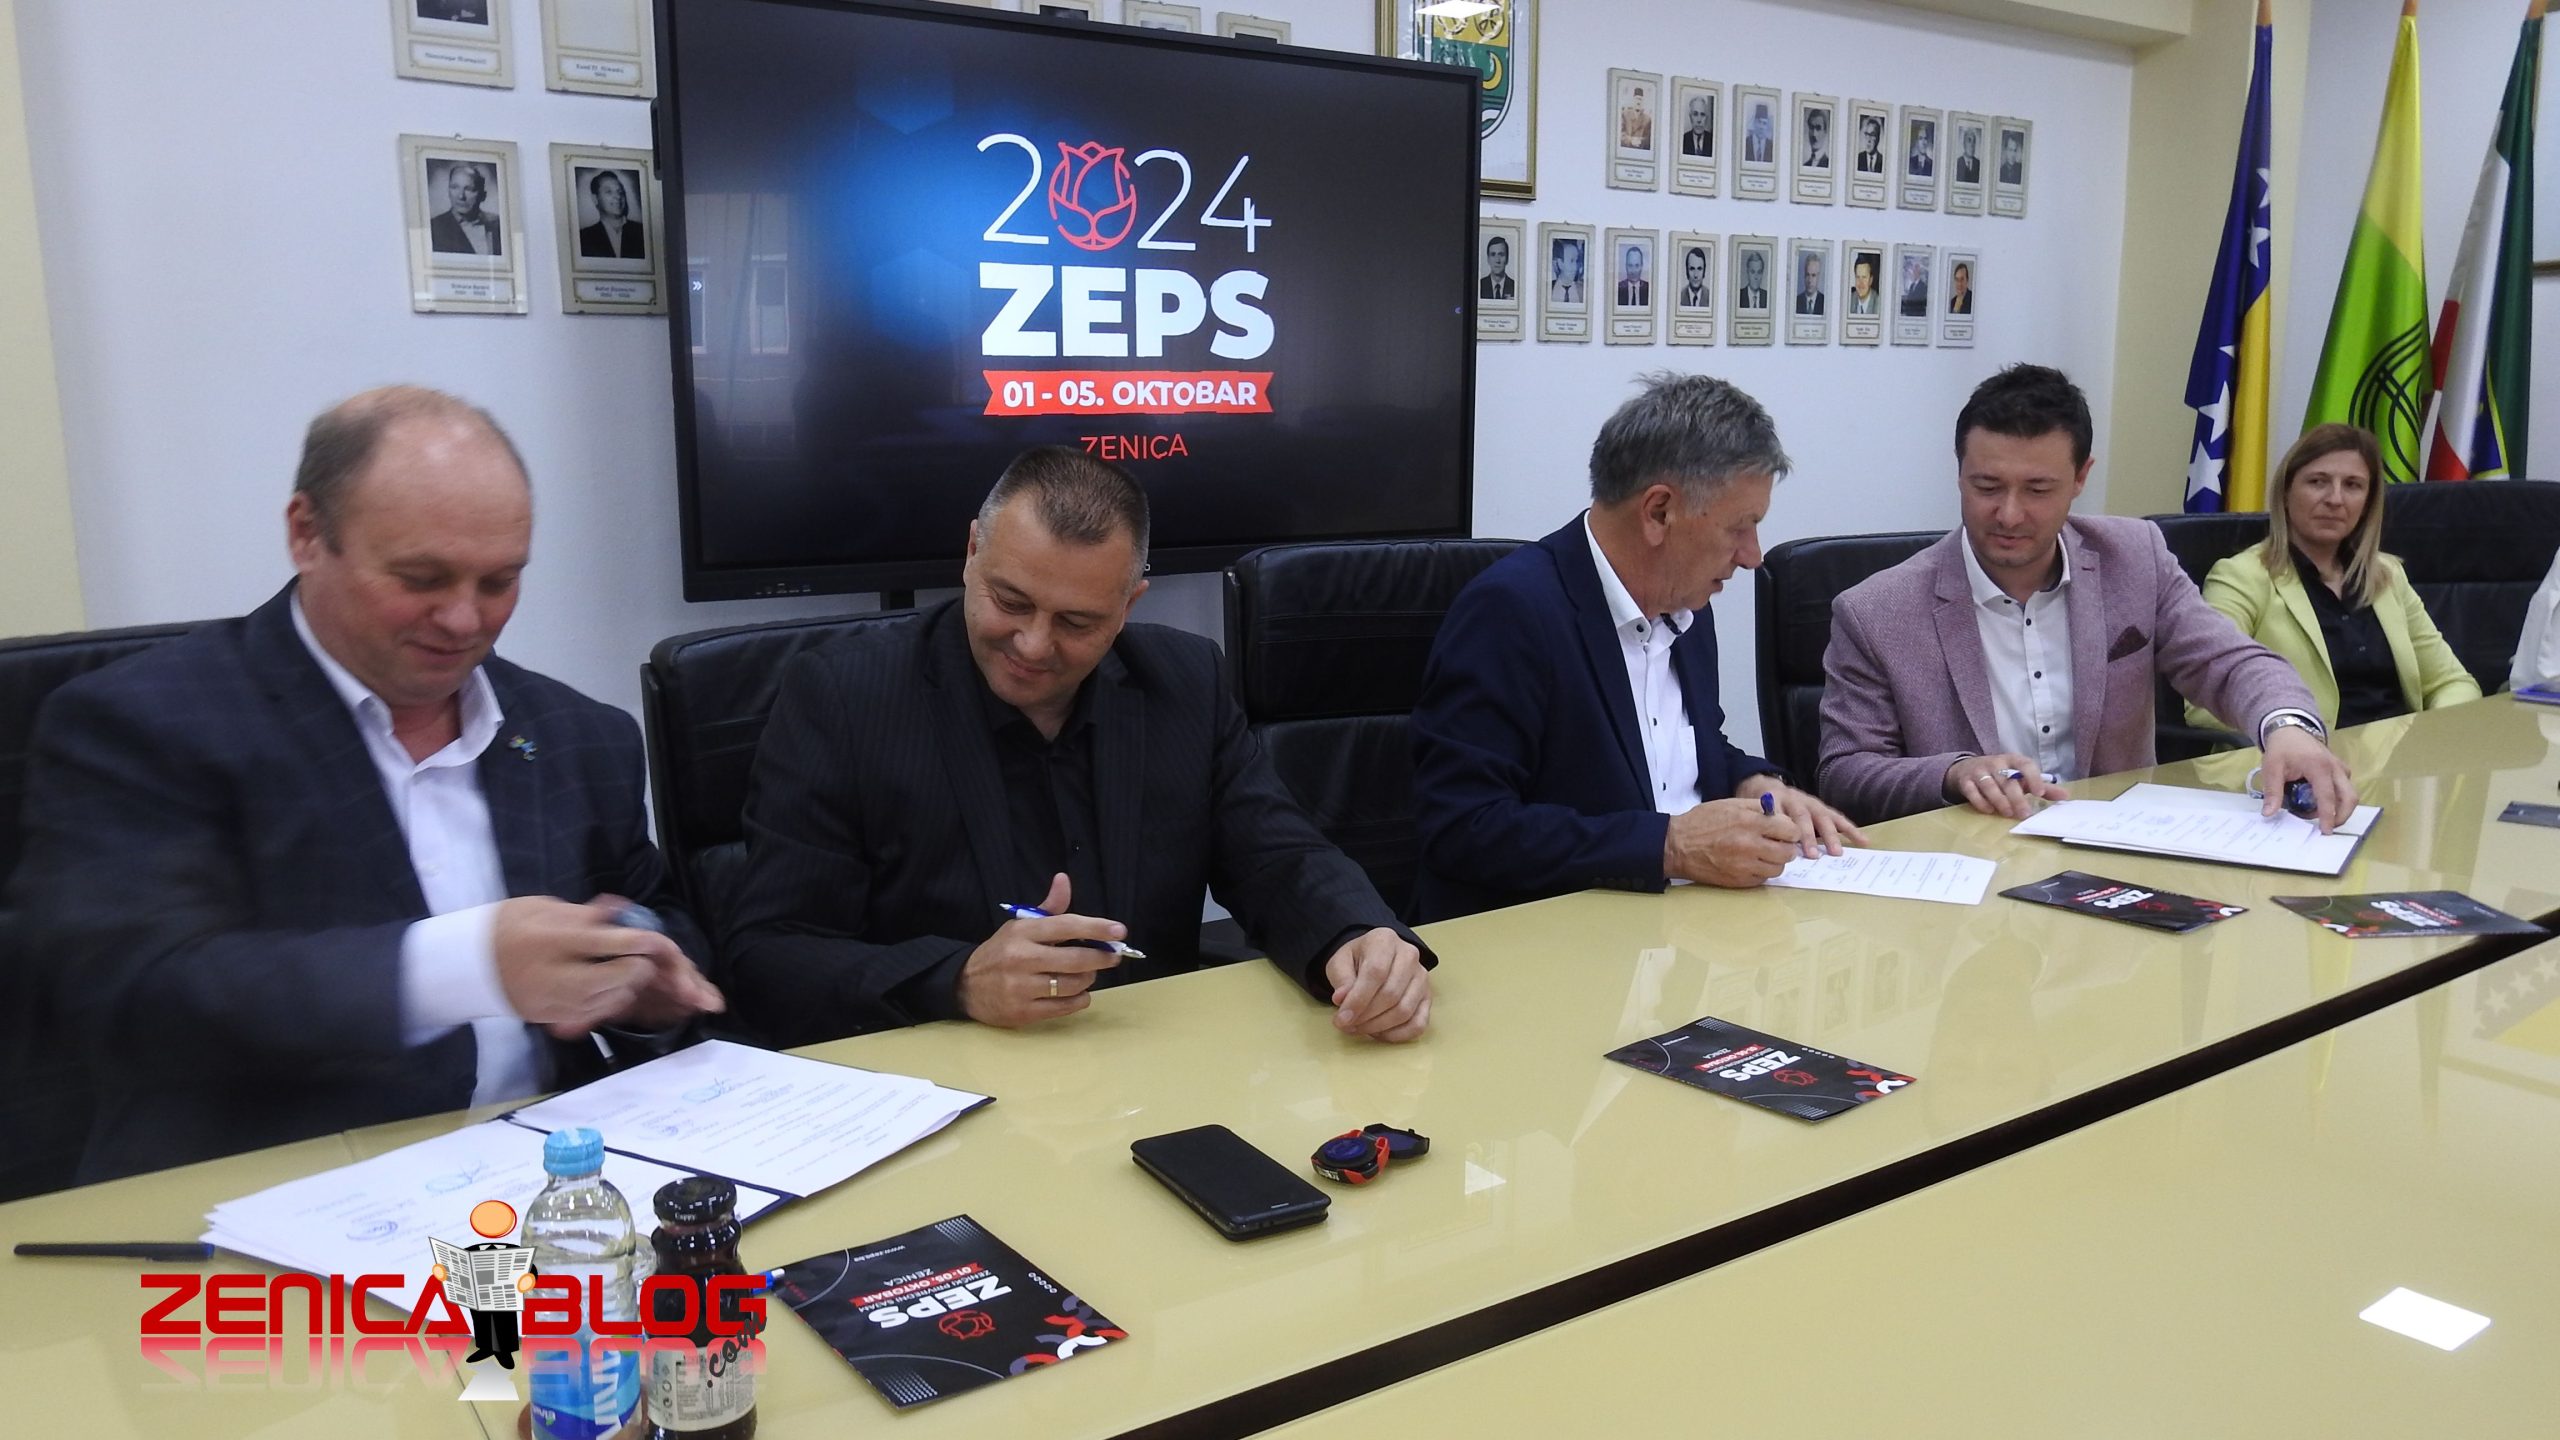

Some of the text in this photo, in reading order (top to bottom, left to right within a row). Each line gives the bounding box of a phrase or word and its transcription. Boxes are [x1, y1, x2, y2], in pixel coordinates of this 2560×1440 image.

[979, 261, 1275, 360] ZEPS
[1003, 381, 1035, 407] 01
[1059, 380, 1105, 407] 05.
[1112, 381, 1257, 406] OKTOBAR
[1080, 434, 1188, 460] ZENICA
[1702, 1047, 1732, 1059] ZENICA
[1719, 1050, 1802, 1082] ZEPS
[883, 1268, 934, 1287] ZENICA
[862, 1279, 931, 1303] OKTOBAR
[868, 1274, 1012, 1329] ZEPS
[895, 1281, 950, 1302] PRIVREDNI
[858, 1298, 895, 1313] SAJAM
